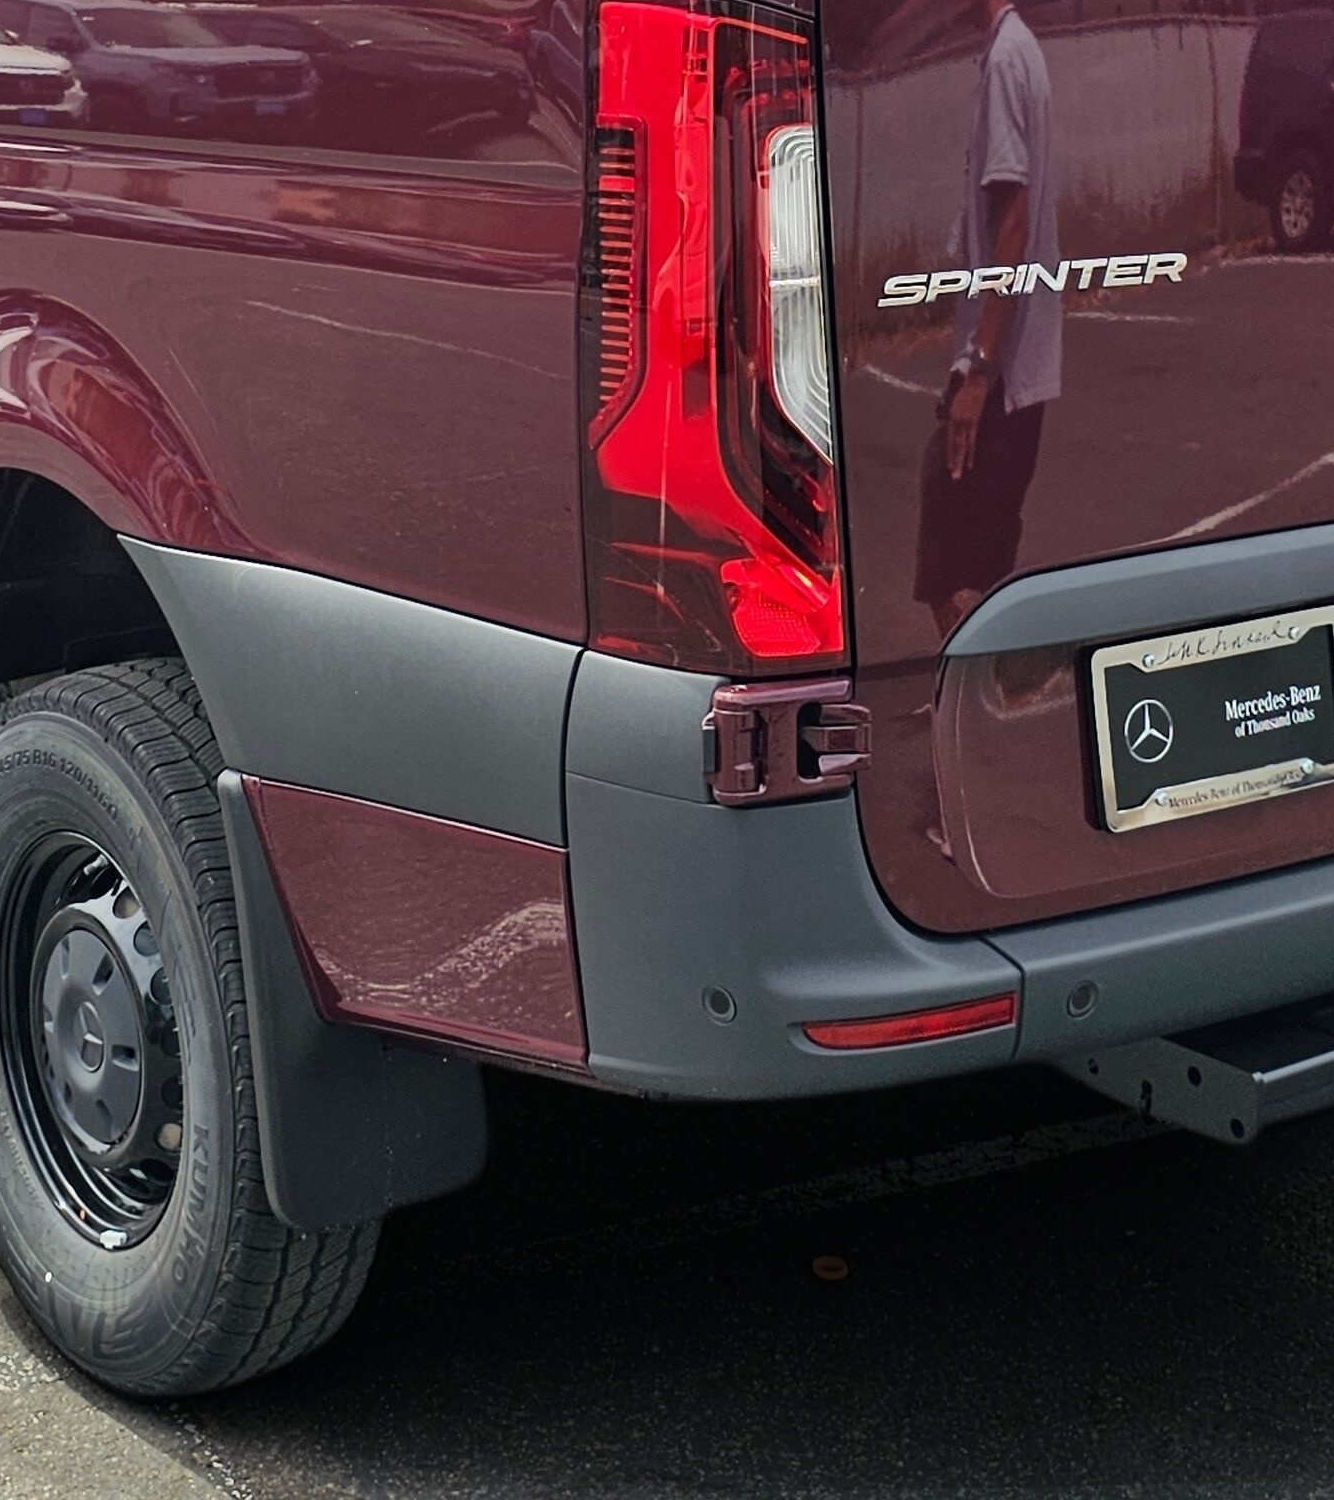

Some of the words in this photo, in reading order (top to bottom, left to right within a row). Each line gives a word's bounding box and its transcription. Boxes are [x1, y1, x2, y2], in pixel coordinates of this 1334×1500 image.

[877, 253, 1188, 308] SPRINTER
[1224, 685, 1322, 721] Mercedes-Benz
[1234, 721, 1246, 738] of
[1246, 710, 1292, 736] Thousand
[1291, 706, 1316, 725] Oaks
[172, 1123, 209, 1287] KUMHO
